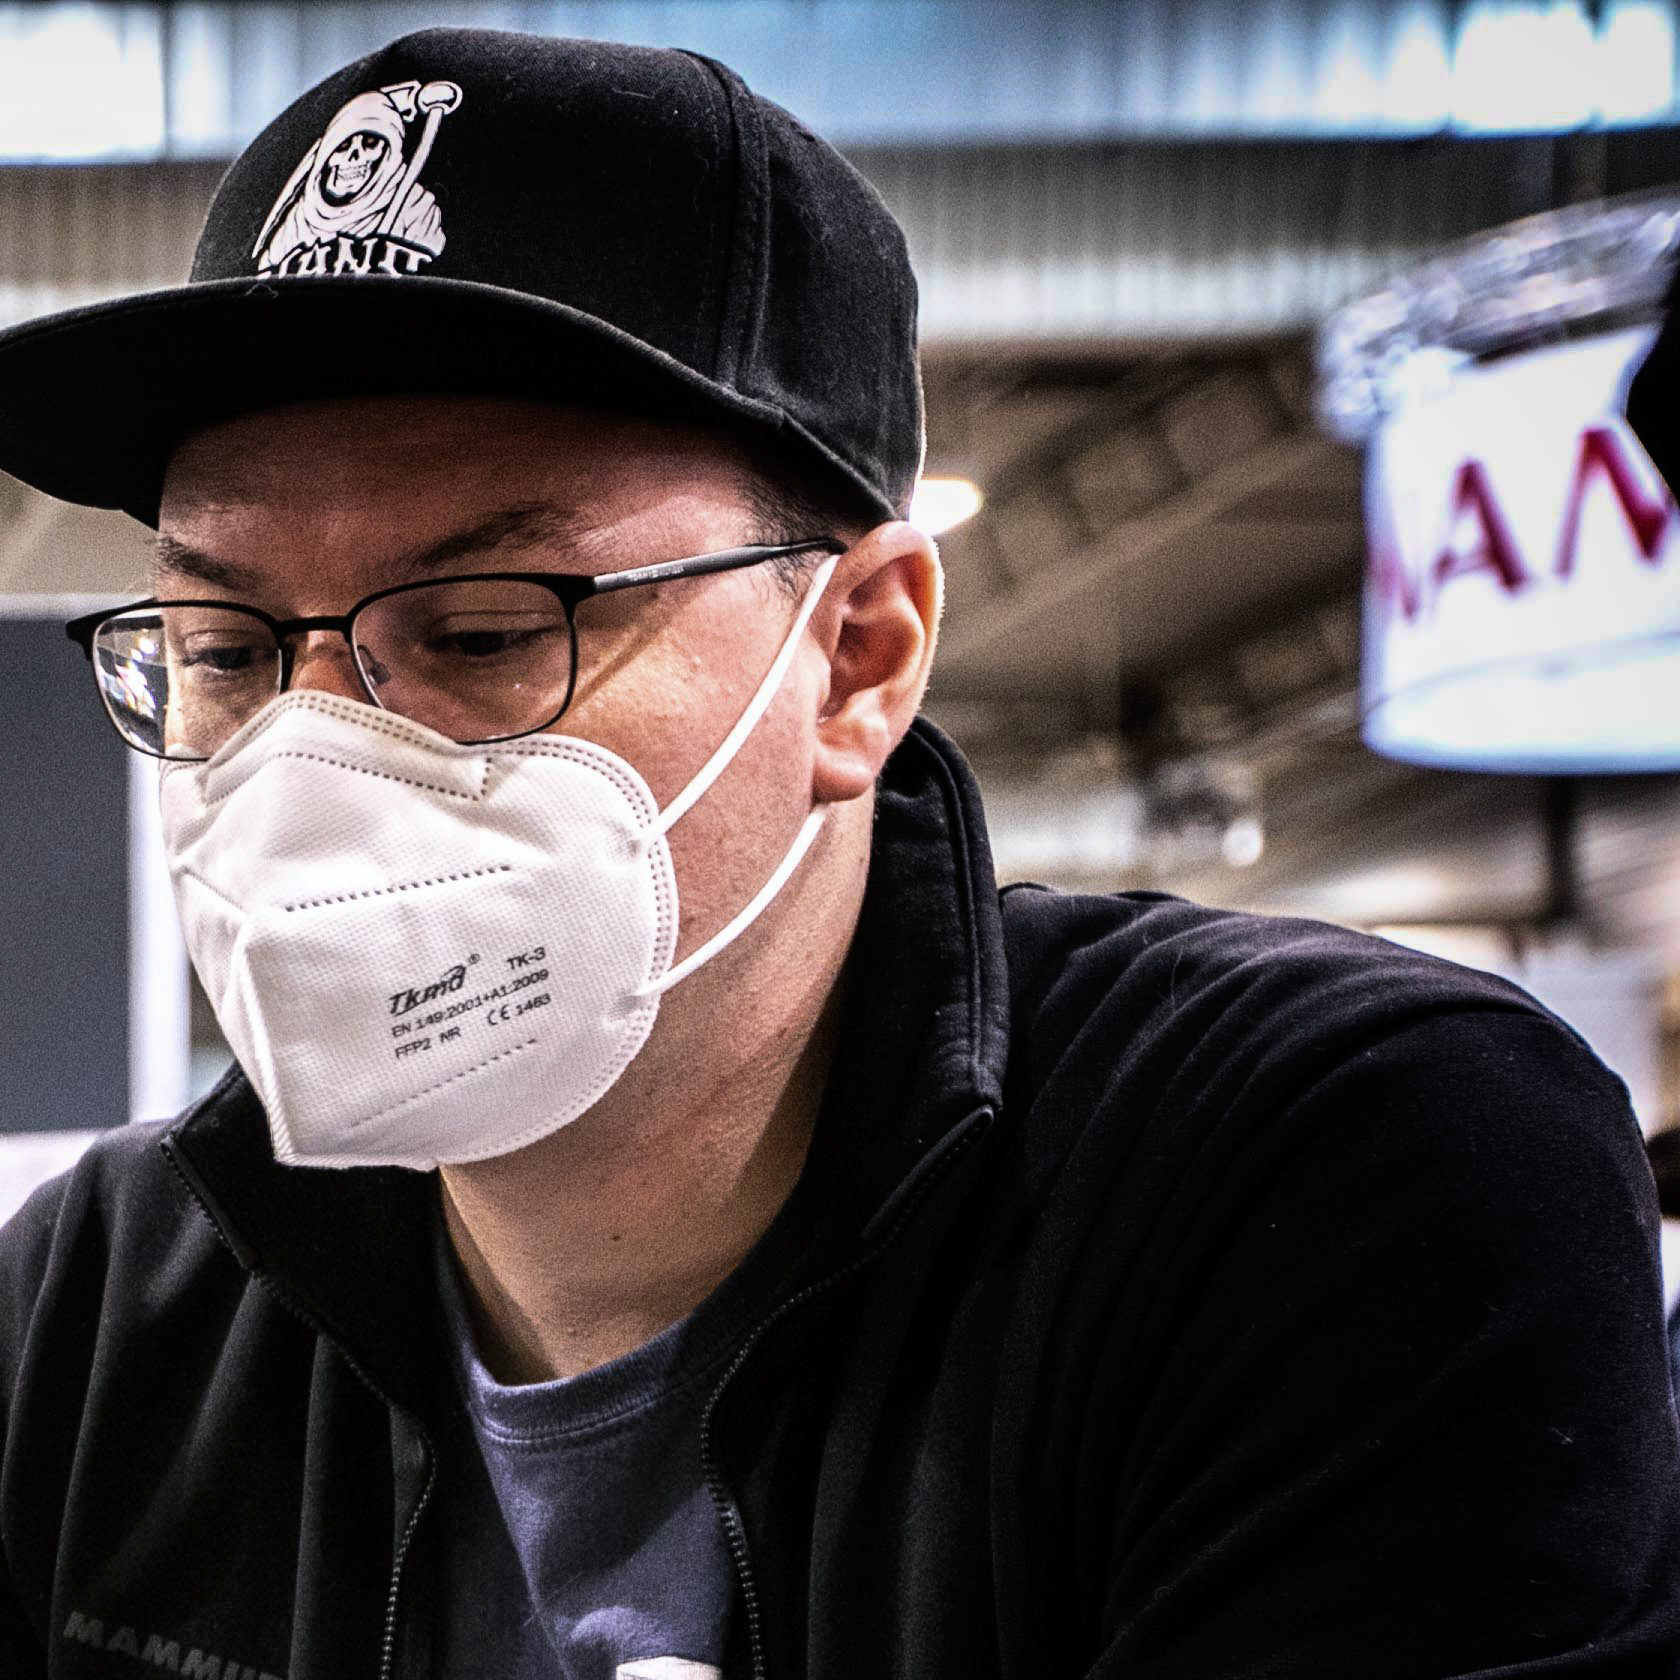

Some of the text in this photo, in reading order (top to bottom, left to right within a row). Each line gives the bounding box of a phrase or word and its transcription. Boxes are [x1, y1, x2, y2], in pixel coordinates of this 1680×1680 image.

[506, 946, 547, 971] TK-3
[391, 1022, 412, 1039] EN
[394, 1037, 433, 1060] FFP2
[439, 1026, 462, 1044] NR
